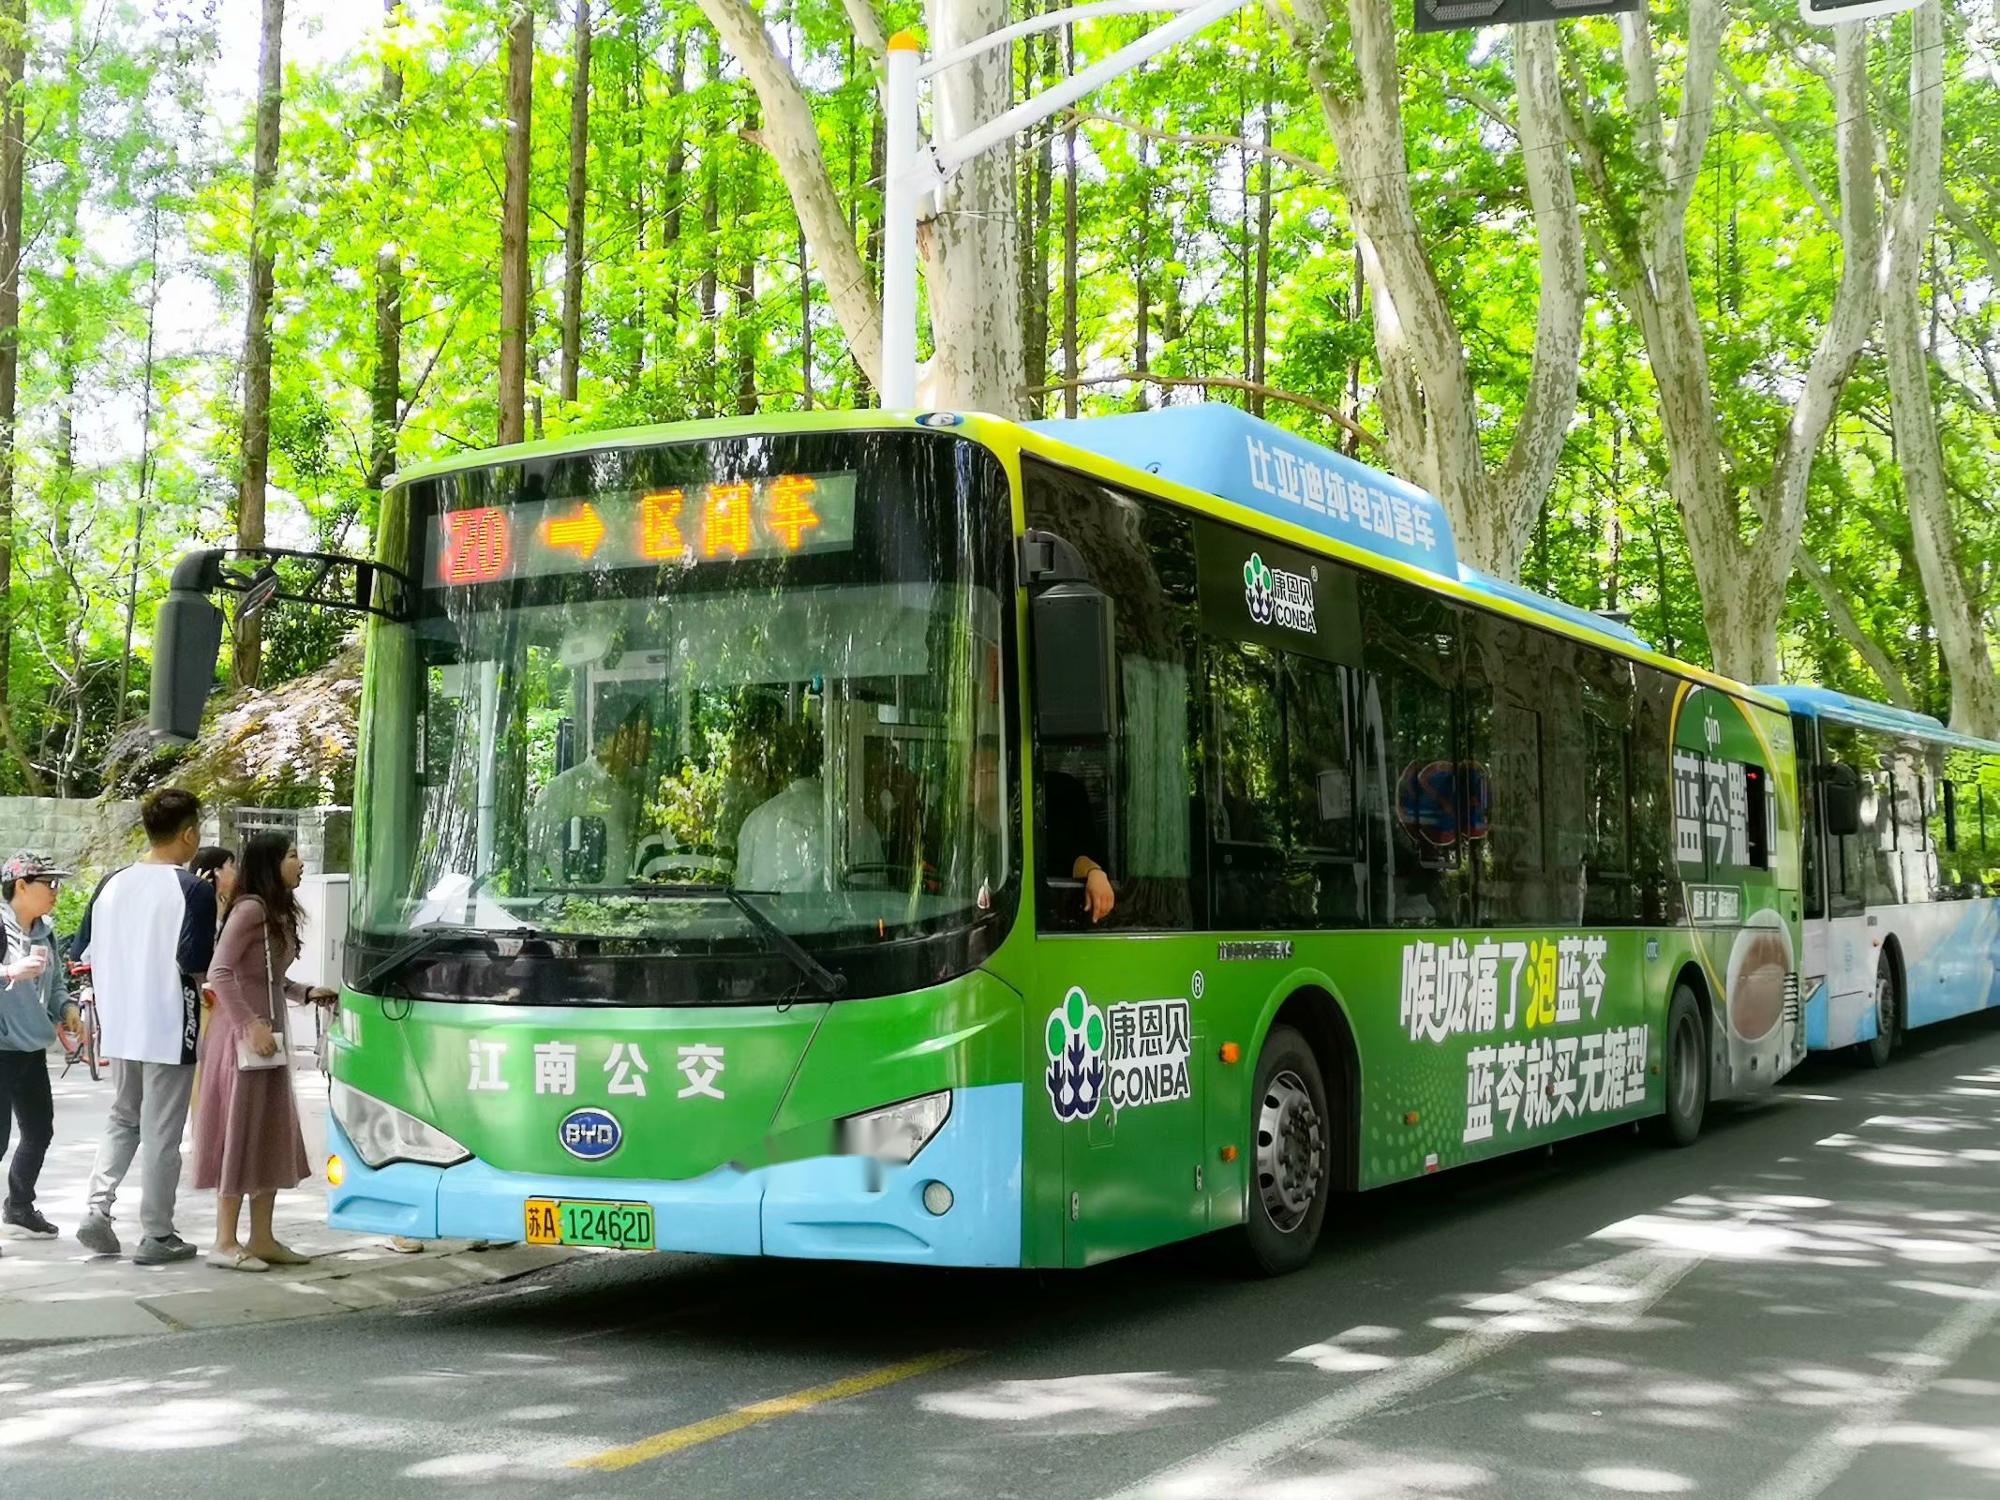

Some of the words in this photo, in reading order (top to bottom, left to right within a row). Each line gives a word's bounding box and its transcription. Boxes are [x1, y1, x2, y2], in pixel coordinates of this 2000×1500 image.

[642, 475, 820, 559] 区间车
[1246, 435, 1435, 550] 比亚迪纯电动客车
[450, 509, 503, 580] 20
[1272, 570, 1313, 609] 康恩贝
[1275, 604, 1316, 632] CONBA
[1704, 705, 1721, 751] qin
[1109, 1002, 1189, 1061] 康恩贝
[467, 1038, 725, 1100] 江南公交
[1109, 1061, 1190, 1105] CONBA
[1463, 1024, 1648, 1143] 蓝芩就买无糖型
[566, 1124, 613, 1145] BYD
